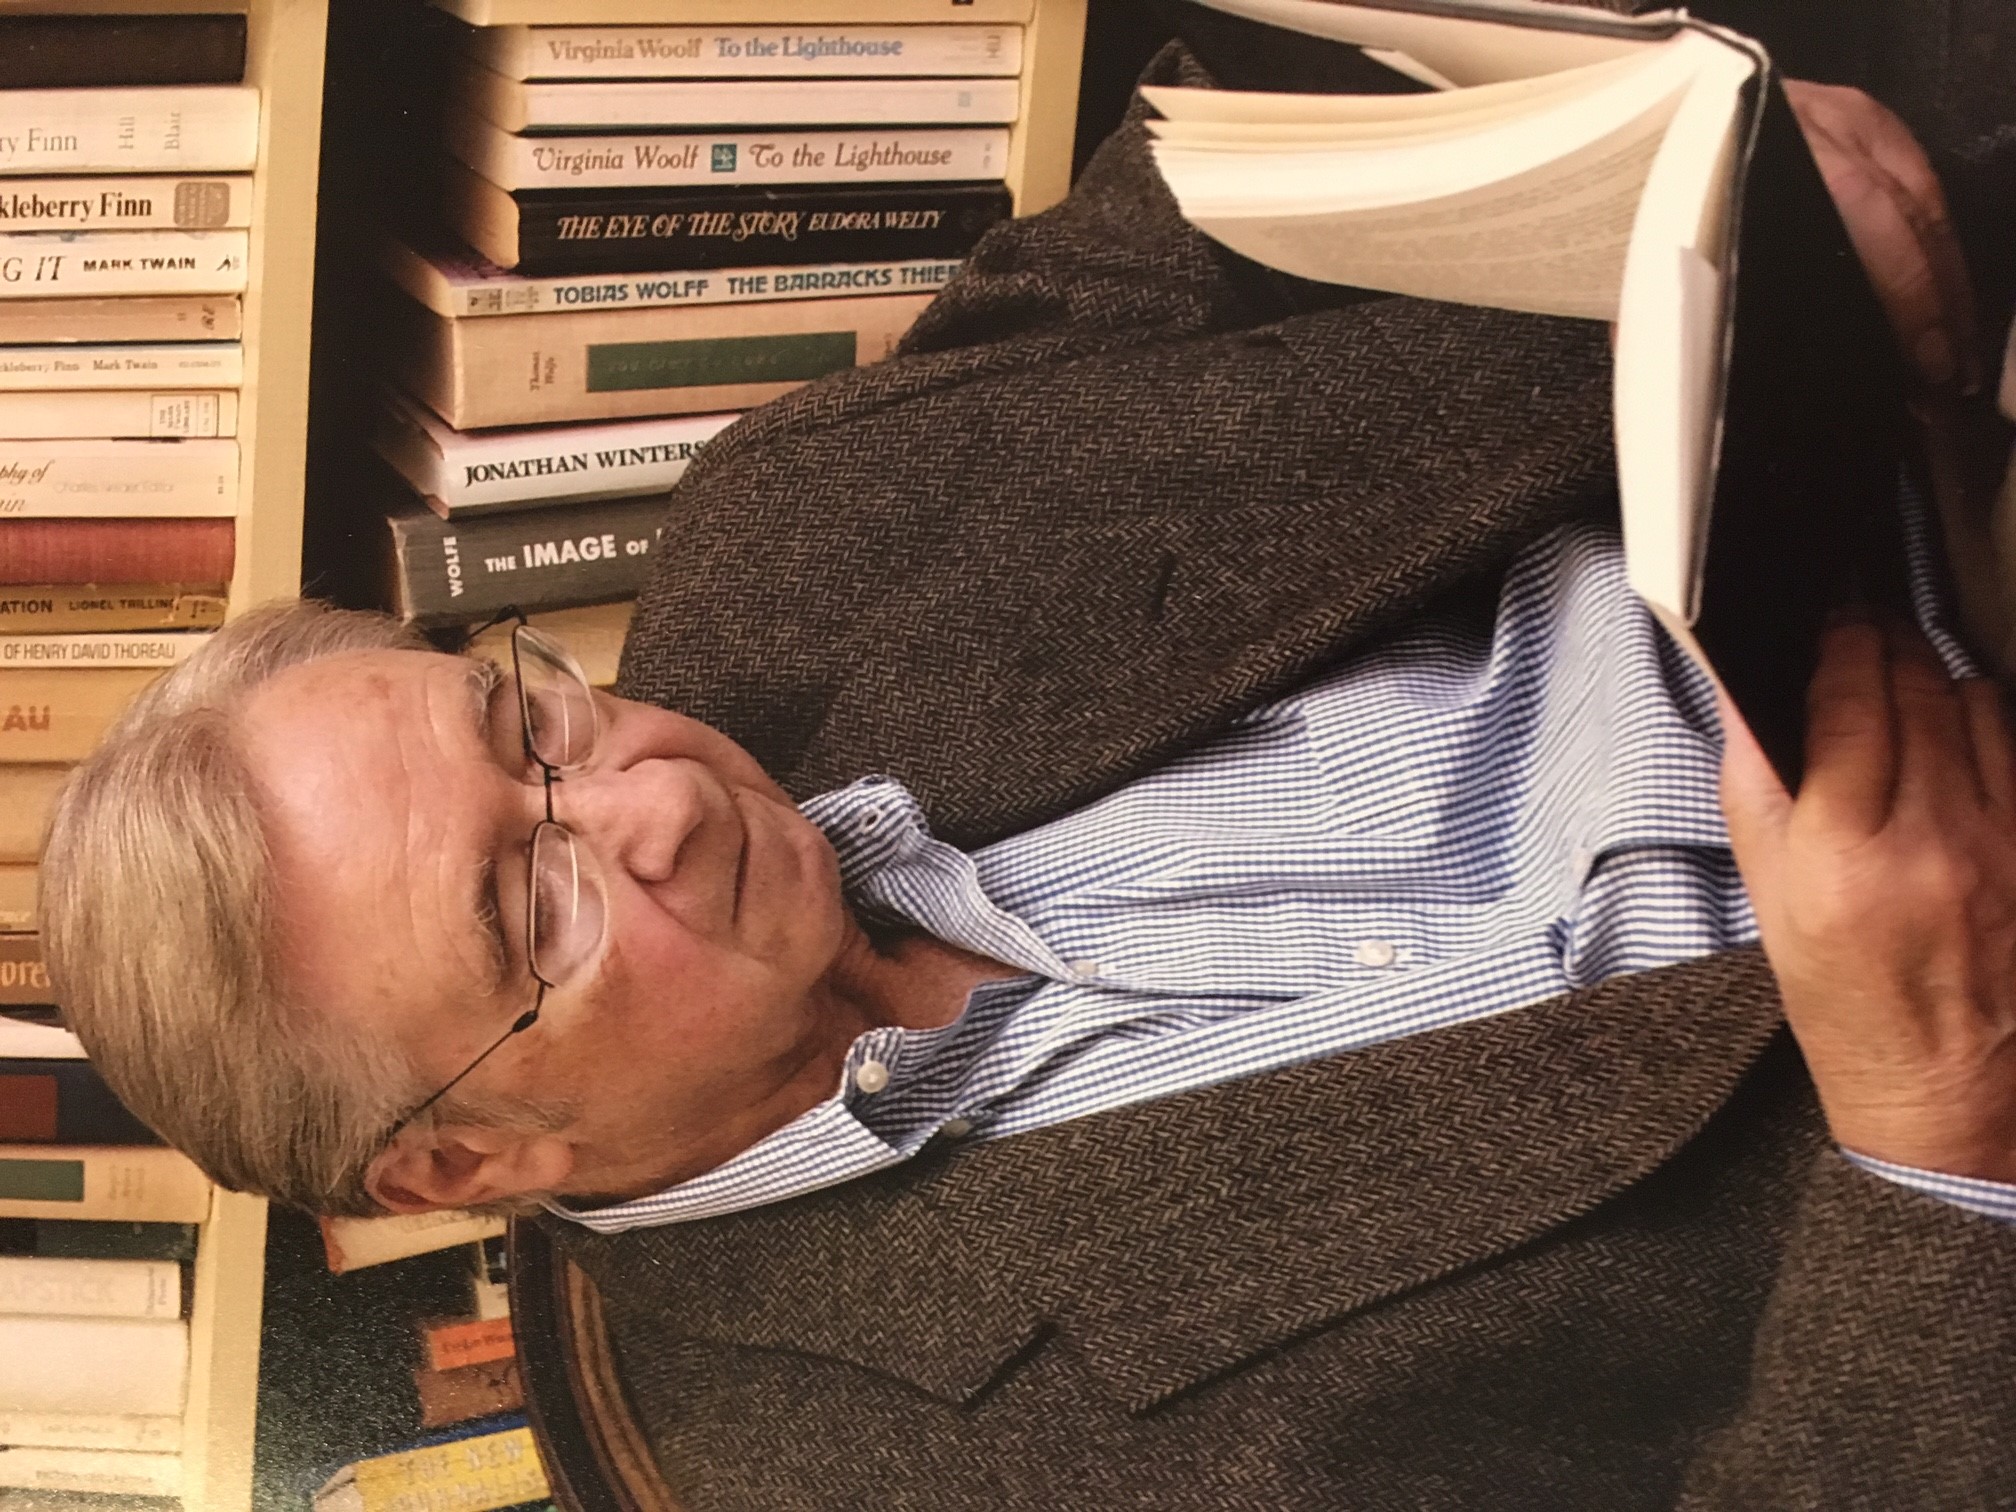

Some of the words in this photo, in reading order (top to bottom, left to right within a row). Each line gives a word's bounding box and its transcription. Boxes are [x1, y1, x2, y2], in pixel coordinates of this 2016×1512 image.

[548, 40, 634, 63] Virginia
[636, 38, 702, 58] Woolf
[714, 37, 742, 58] To
[745, 37, 778, 57] the
[782, 36, 903, 61] Lighthouse
[28, 128, 77, 152] Finn
[532, 147, 624, 176] Virginia
[634, 144, 699, 169] Woolf
[749, 143, 784, 168] To
[792, 142, 825, 167] the
[834, 141, 952, 172] Lighthouse
[100, 192, 152, 216] Finn
[557, 214, 604, 240] THE
[603, 214, 650, 239] EYE
[651, 213, 685, 238] OF
[688, 211, 736, 236] THE
[732, 210, 806, 242] STORY
[807, 211, 880, 232] EUDORA
[885, 210, 946, 229] WELTY
[35, 256, 68, 281] IT
[84, 260, 133, 271] MARK
[139, 258, 196, 270] TWAIN
[553, 284, 629, 306] TOBIAS
[636, 279, 709, 301] WOLFF
[727, 276, 767, 295] THE
[774, 268, 893, 292] BARRACKS
[93, 360, 121, 370] Mark
[125, 359, 158, 370] Twain
[465, 453, 588, 487] JONATHAN
[484, 556, 518, 572] THE
[523, 534, 617, 568] IMAGE
[626, 539, 649, 556] OF
[443, 536, 464, 598] WOLFE
[0, 599, 53, 614] ATION
[69, 599, 114, 611] LIONEL
[4, 644, 21, 659] OF
[23, 643, 67, 659] HENRY
[72, 643, 110, 659] DAVID
[114, 643, 176, 659] THOREAU
[2, 704, 50, 731] AU
